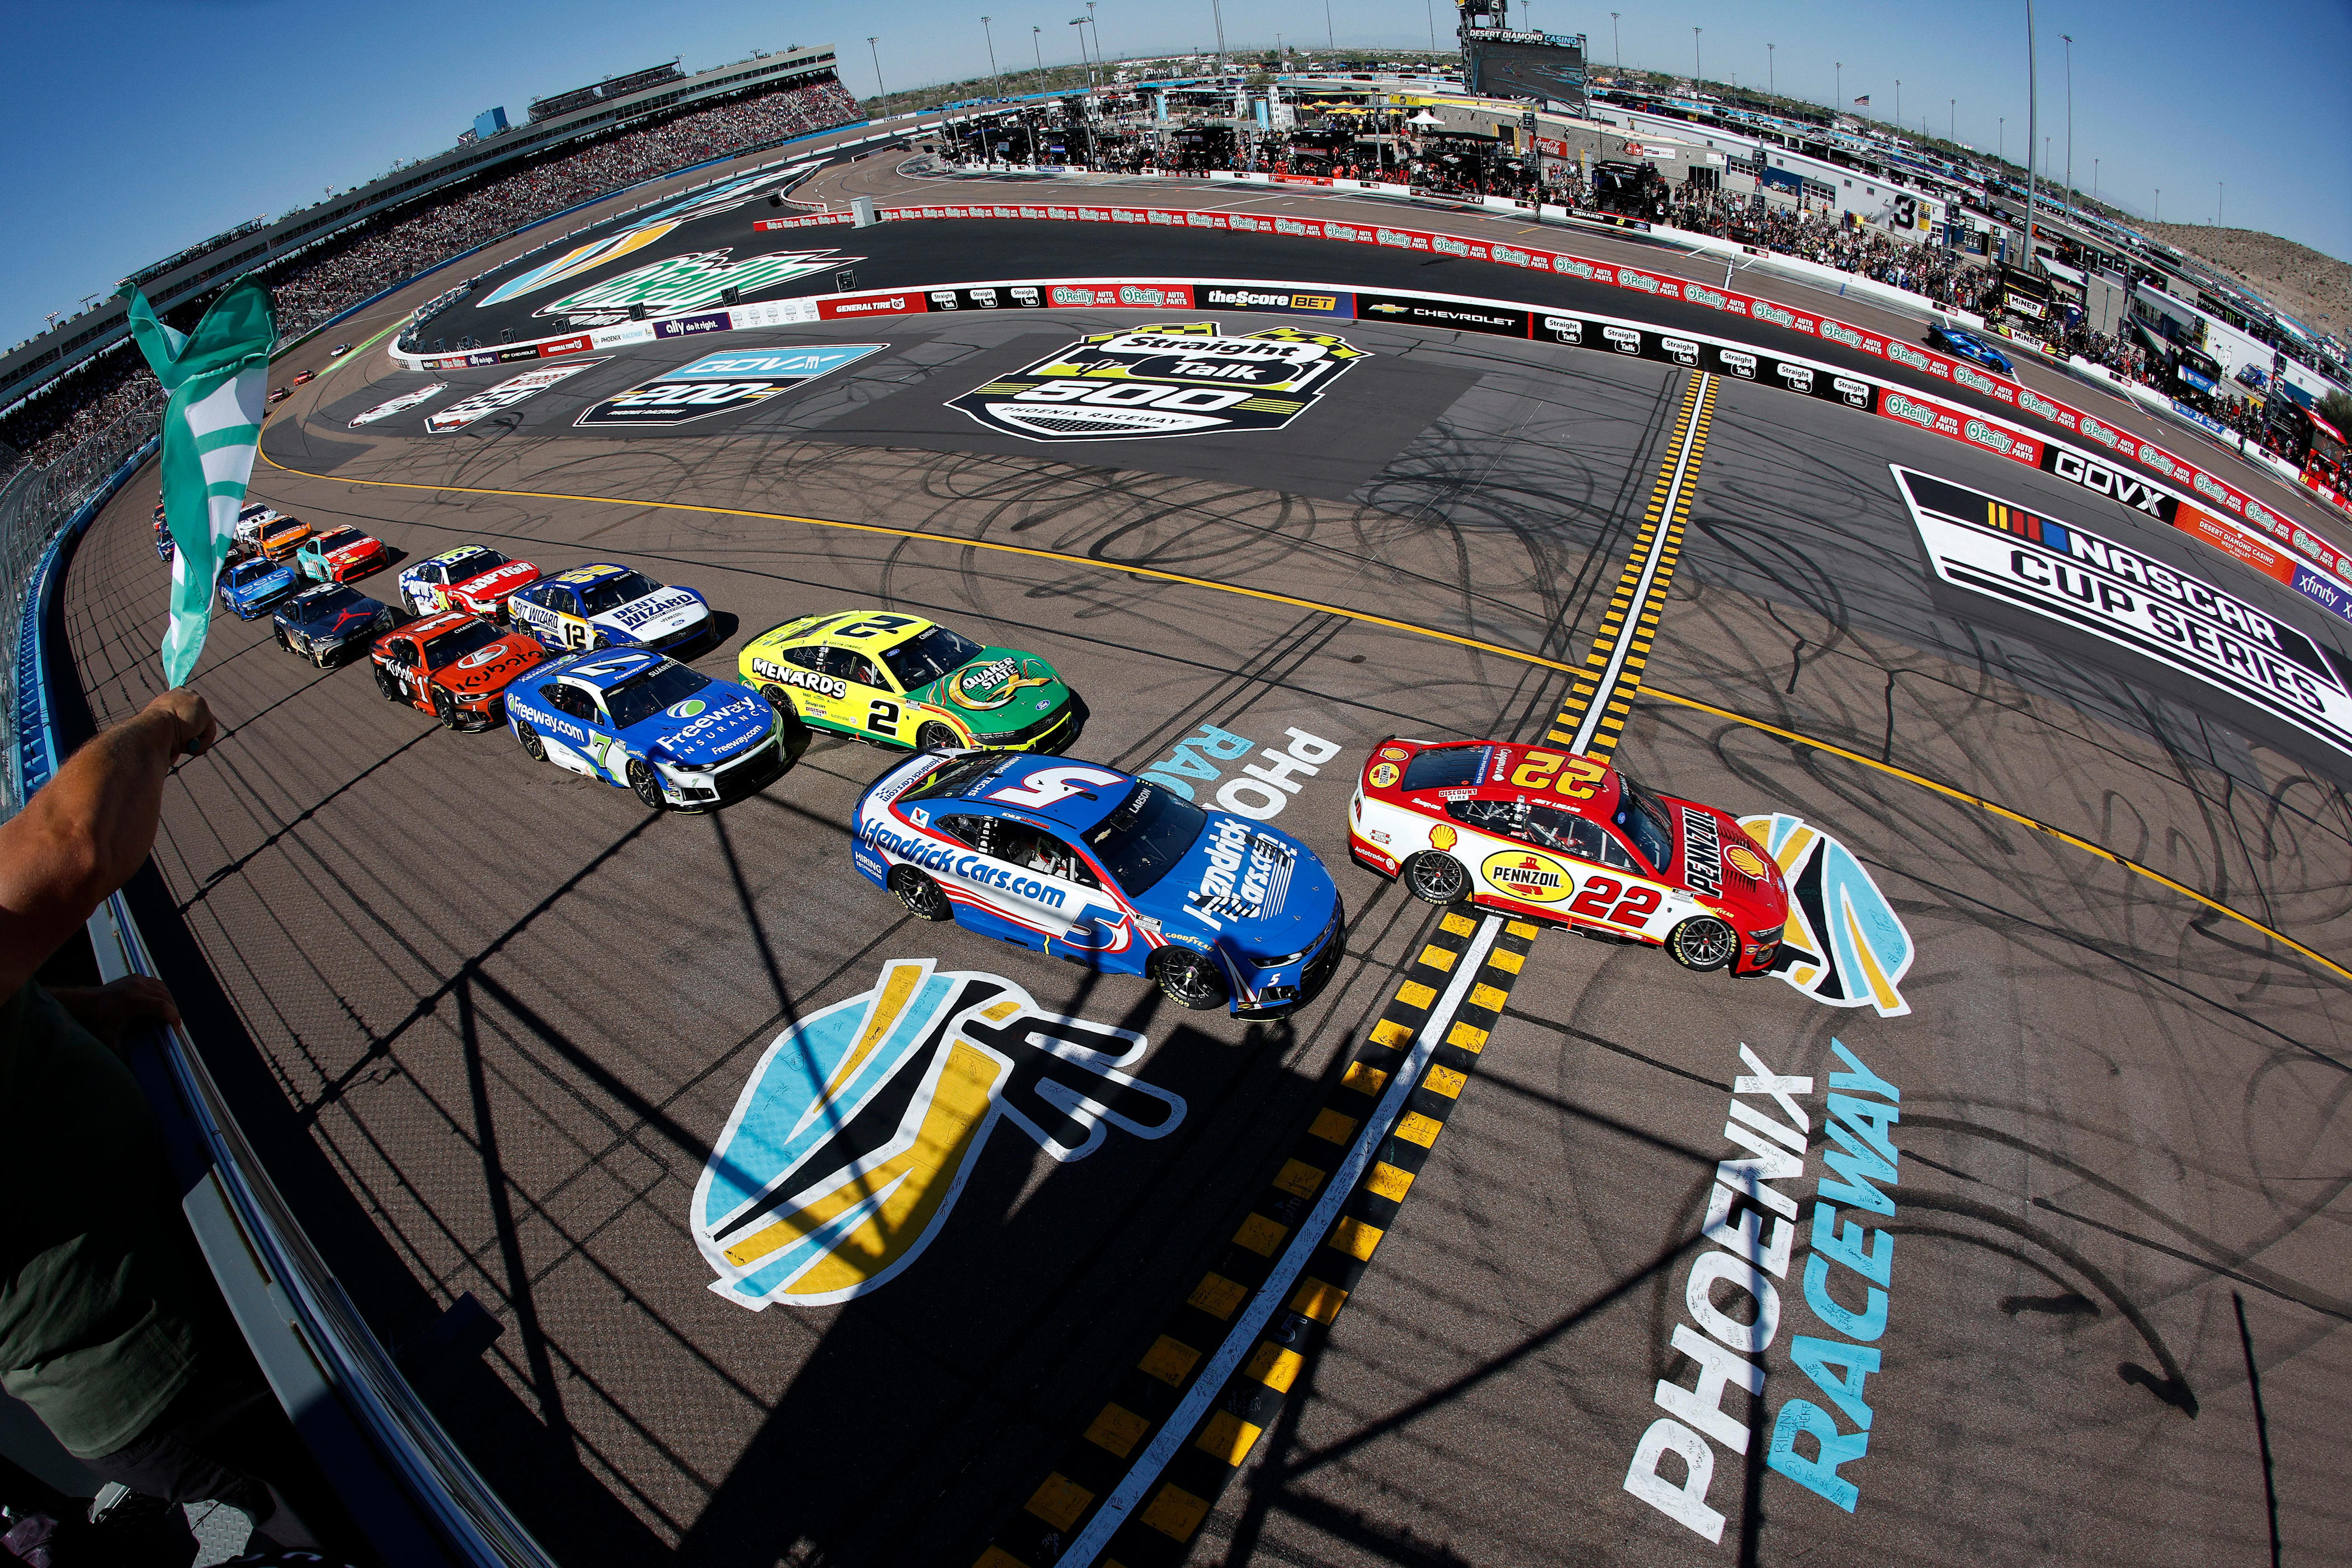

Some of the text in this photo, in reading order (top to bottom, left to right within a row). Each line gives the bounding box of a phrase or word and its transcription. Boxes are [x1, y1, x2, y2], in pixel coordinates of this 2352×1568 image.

[1470, 29, 1578, 45] DESERT DIAMOND CASINO
[1572, 210, 1604, 220] MENARDS
[1893, 195, 1917, 230] 3
[1555, 258, 1593, 277] O'Reilly
[1054, 287, 1093, 304] O'Reilly
[1208, 290, 1333, 309] theScore BET
[1686, 286, 1726, 308] O'Reilly
[2011, 296, 2038, 311] MINER
[836, 301, 891, 312] GENERAL TIRE
[666, 320, 684, 335] ally
[687, 323, 695, 332] do
[700, 320, 718, 330] right.
[1414, 309, 1515, 326] CHEVROLET
[1549, 320, 1578, 330] Straight
[622, 330, 643, 339] RACEWAY
[1562, 333, 1577, 342] Talk
[1608, 329, 1636, 341] Straight
[1865, 338, 1881, 348] AUTO
[2014, 331, 2041, 347] MINER
[1120, 336, 1300, 360] Straight
[1621, 343, 1635, 352] Talk
[1862, 343, 1882, 355] PARTS
[1889, 344, 1929, 370] O'Reilly
[683, 355, 845, 374] GOVX
[1724, 353, 1753, 364] Straight
[1169, 360, 1267, 380] Talk
[1737, 367, 1751, 376] Talk
[1955, 367, 1995, 394] O'Reilly
[612, 382, 774, 407] 200
[1013, 380, 1254, 411] 500
[1838, 381, 1865, 393] Straight
[1849, 395, 1863, 405] Talk
[1000, 406, 1183, 426] PHOENIX RACEWAY
[1887, 395, 1936, 427] O'Reilly
[1939, 415, 1958, 427] AUTO
[2060, 411, 2075, 422] AUTO
[2193, 413, 2204, 423] 34
[1936, 422, 1958, 435] PARTS
[2057, 417, 2075, 429] PARTS
[2081, 418, 2117, 448] O'Reilly
[1966, 421, 2013, 454] O'Reilly
[2015, 442, 2033, 454] AUTO
[2013, 448, 2033, 462] PARTS
[2173, 472, 2190, 484] PARTS
[2176, 466, 2190, 478] AUTO
[2299, 474, 2310, 484] 24
[2055, 451, 2166, 518] GOVX
[2194, 474, 2226, 504] O'Reilly
[2199, 521, 2223, 537] DESERT
[2223, 533, 2251, 552] DIAMOND
[2252, 549, 2274, 564] CASINO
[2221, 540, 2234, 551] WEST
[2235, 547, 2251, 559] VALLEY
[473, 551, 489, 559] BYRON
[239, 569, 289, 595] eero
[458, 561, 533, 594] RAPTOR
[613, 572, 632, 582] BLANEY
[434, 589, 451, 611] 24
[2069, 531, 2282, 649] NASCAR
[2298, 574, 2339, 607] xfinity
[513, 600, 559, 629] DENT WIZARD
[612, 596, 657, 620] DENT
[620, 594, 693, 628] WIZARD
[454, 618, 481, 634] CHASTAIN
[564, 622, 587, 650] 12
[833, 615, 920, 639] 2
[919, 626, 939, 640] CINDRIC
[2011, 550, 2326, 714] CUP SERIES
[386, 659, 415, 686] Kubota
[455, 651, 542, 691] Kubota
[614, 662, 651, 681] Freeway.com
[648, 660, 674, 678] SUÁREZ
[753, 658, 847, 700] MENARDS
[962, 656, 1017, 690] QUAKER
[982, 667, 1018, 691] STATE
[417, 676, 429, 704] 1
[513, 696, 585, 743] Freeway.com
[655, 696, 757, 752] Freeway
[867, 698, 900, 737] 2
[677, 707, 769, 760] INSURANCE
[711, 724, 763, 756] Freeway.com
[592, 733, 613, 769] 7
[1380, 763, 1391, 785] PENNZOIL
[1476, 746, 1492, 784] FORD RACING
[1511, 750, 1609, 800] 22
[691, 778, 700, 788] 7
[967, 755, 1023, 797] HIRING TECHS
[985, 765, 1127, 810] 5
[1439, 788, 1478, 797] DISCOUNT
[1129, 787, 1152, 815] LARSON
[1411, 797, 1442, 811] Snap-on
[1531, 798, 1581, 813] JOEY LOGANO
[855, 851, 882, 874] HIRING
[1354, 846, 1386, 863] Autotrader
[1682, 806, 1723, 899] PENNZOIL
[1492, 866, 1561, 888] PENNZOIL
[1474, 904, 1523, 919] FORD RACING
[1568, 875, 1663, 929] 22
[1061, 899, 1130, 951] 5
[1165, 932, 1215, 953] GOODYEAR
[1267, 972, 1281, 988] 5
[1767, 1036, 1900, 1514] RACEWAY
[1622, 1041, 1813, 1545] PHOENIX
[1799, 1402, 1812, 1428] HERE
